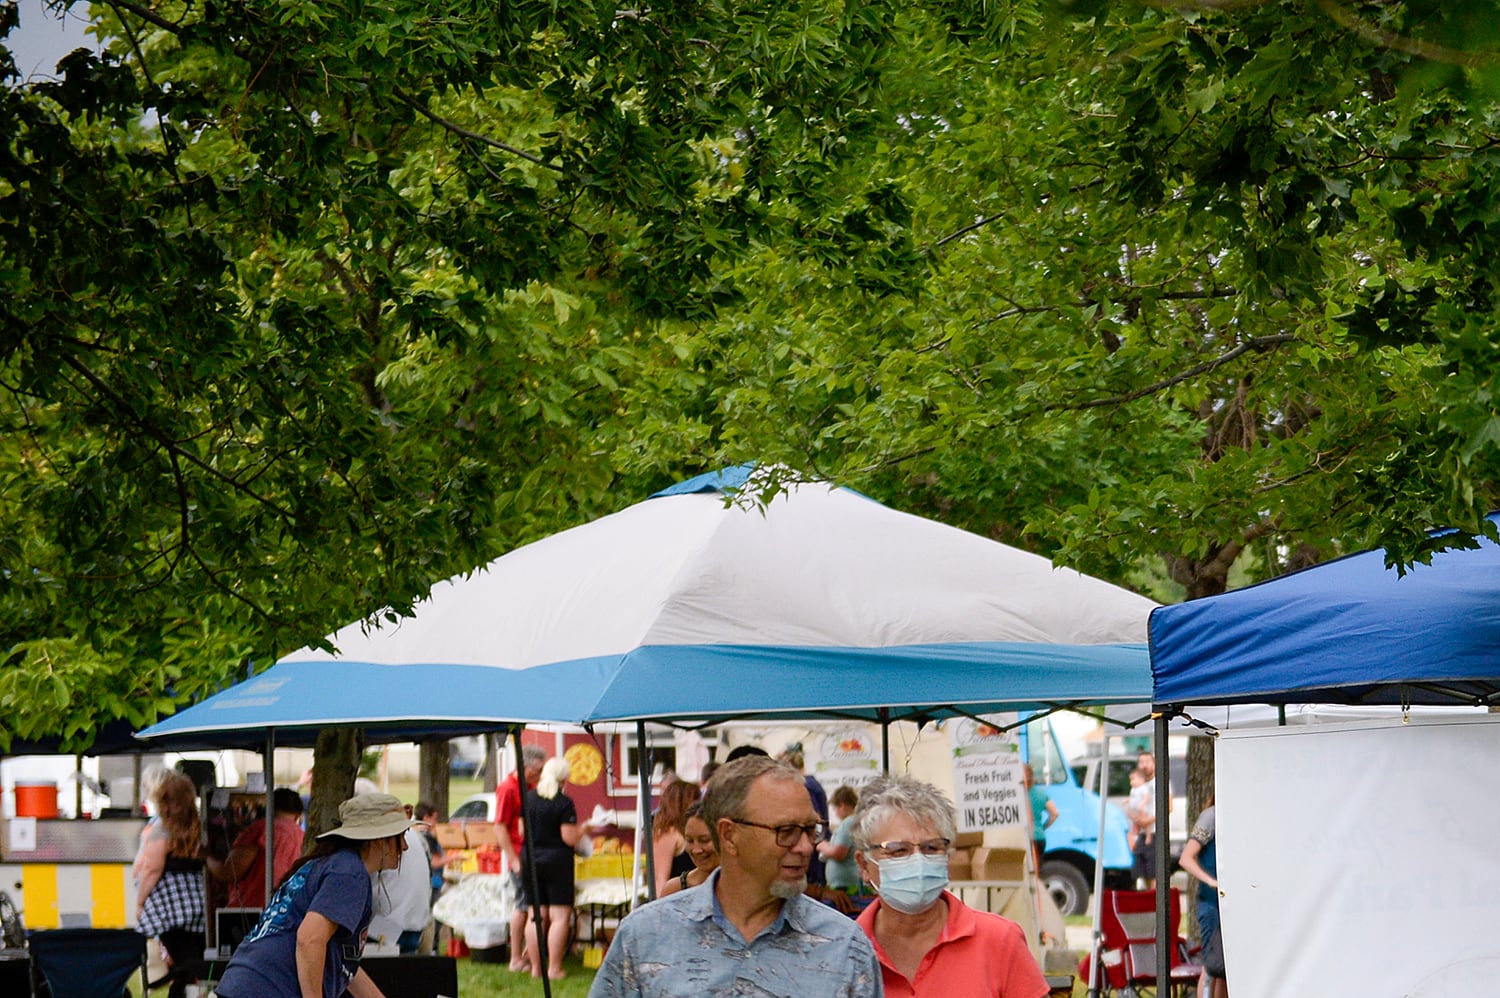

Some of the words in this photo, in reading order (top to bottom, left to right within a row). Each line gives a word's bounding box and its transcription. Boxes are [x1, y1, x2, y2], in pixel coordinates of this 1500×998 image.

[965, 772, 989, 784] Fresh
[992, 770, 1012, 781] Fruit
[964, 790, 980, 801] and
[982, 788, 1017, 802] Veggies
[964, 807, 976, 827] IN
[979, 804, 1020, 826] SEASON
